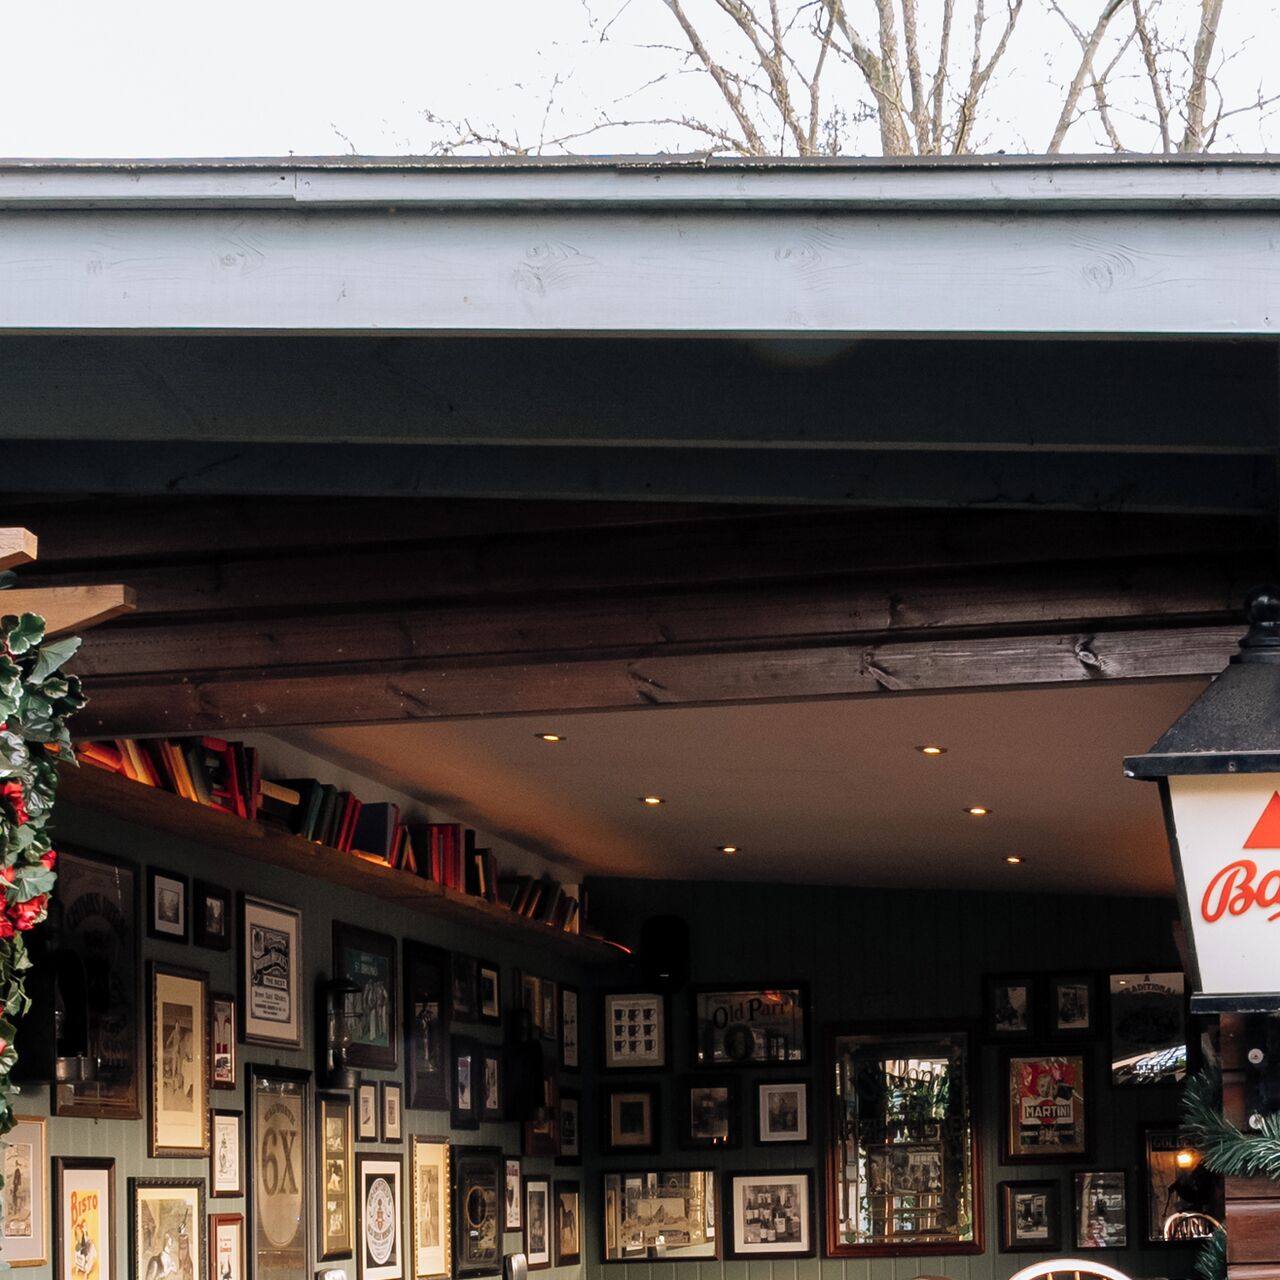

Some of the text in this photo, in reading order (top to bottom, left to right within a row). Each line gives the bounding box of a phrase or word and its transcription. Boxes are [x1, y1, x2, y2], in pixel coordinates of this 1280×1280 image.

[713, 1002, 744, 1030] Old
[1024, 1105, 1071, 1119] MARTINI
[261, 1127, 299, 1198] 6X
[71, 1191, 98, 1228] BISTO
